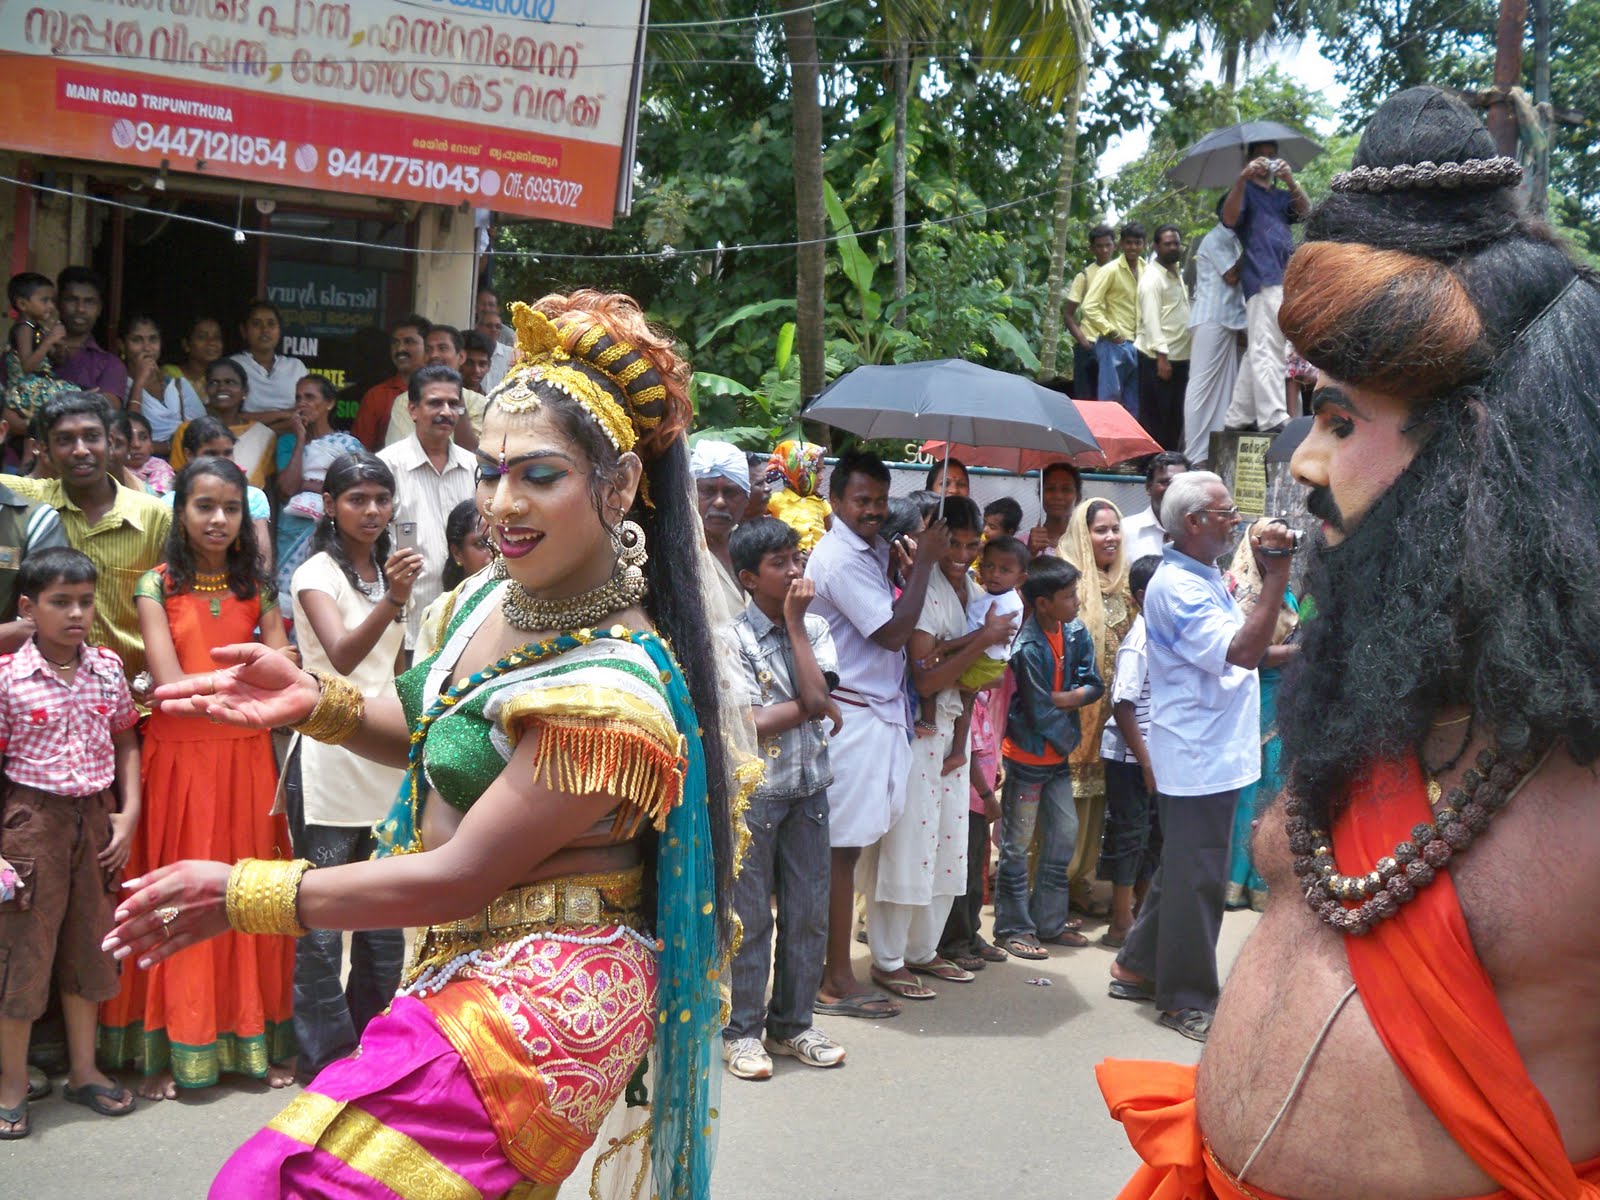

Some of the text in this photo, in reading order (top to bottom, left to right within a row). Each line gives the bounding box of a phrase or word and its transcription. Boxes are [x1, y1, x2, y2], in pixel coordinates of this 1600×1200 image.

[66, 83, 233, 122] MAIN ROAD TRIPUNITHURA
[135, 121, 287, 170] 9447121954
[327, 147, 480, 194] 9447751043
[283, 335, 318, 357] PLAN
